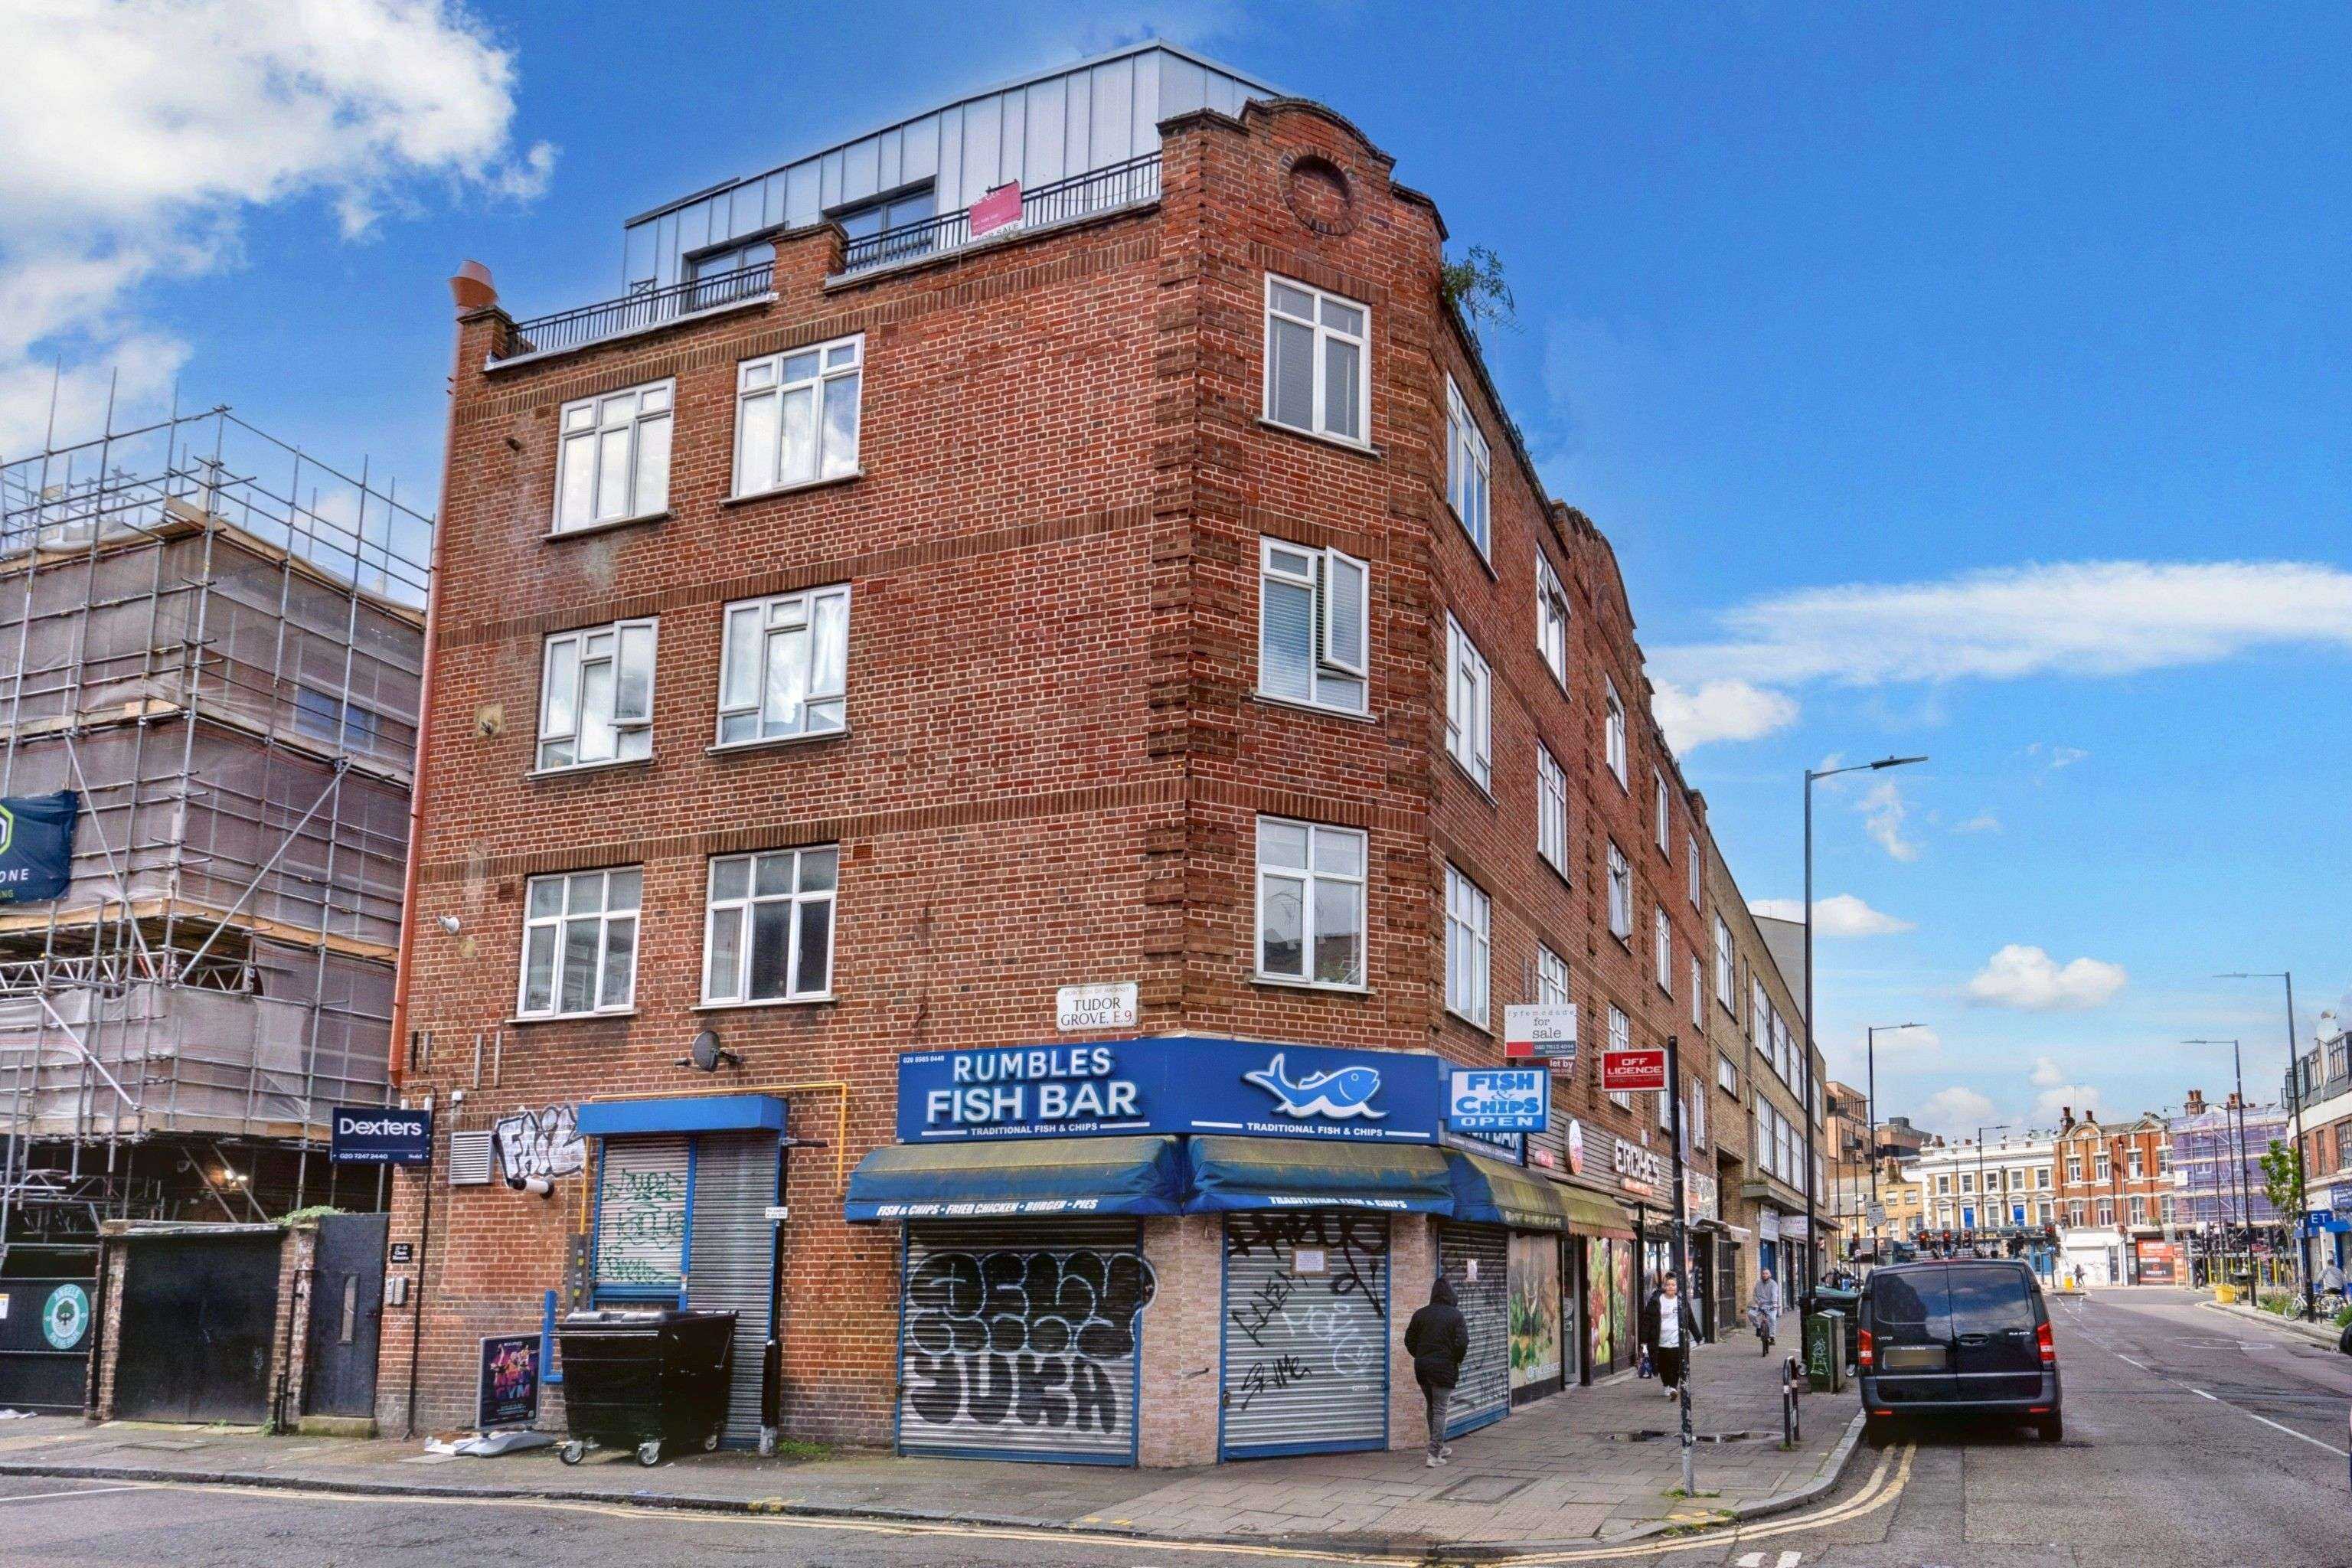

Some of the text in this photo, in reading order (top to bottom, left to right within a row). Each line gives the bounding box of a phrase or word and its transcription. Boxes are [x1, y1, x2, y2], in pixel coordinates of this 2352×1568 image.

[1073, 998, 1121, 1011] TUDOR
[1534, 1018, 1550, 1026] for
[1532, 1027, 1561, 1039] sale
[954, 1047, 1110, 1082] RUMBLES
[1563, 1060, 1573, 1069] by
[1608, 1066, 1663, 1075] LICENCE
[1468, 1073, 1535, 1090] FISH
[927, 1080, 1137, 1122] FISH BAR
[1455, 1096, 1539, 1114] CHIPS
[339, 1118, 422, 1135] Dexters
[1461, 1117, 1534, 1126] OPEN
[971, 1126, 1032, 1135] TRADITIONAL
[1034, 1124, 1056, 1132] FISH
[1069, 1122, 1097, 1132] CHIPS
[1246, 1122, 1383, 1137] TRADITIONAL FISH & CHIPS
[877, 1199, 1098, 1216] FISH & CHIPS FRIED CHICKEN BURGER PIES
[1268, 1196, 1339, 1205] TRADITIONAL
[1375, 1199, 1407, 1209] CHIPS
